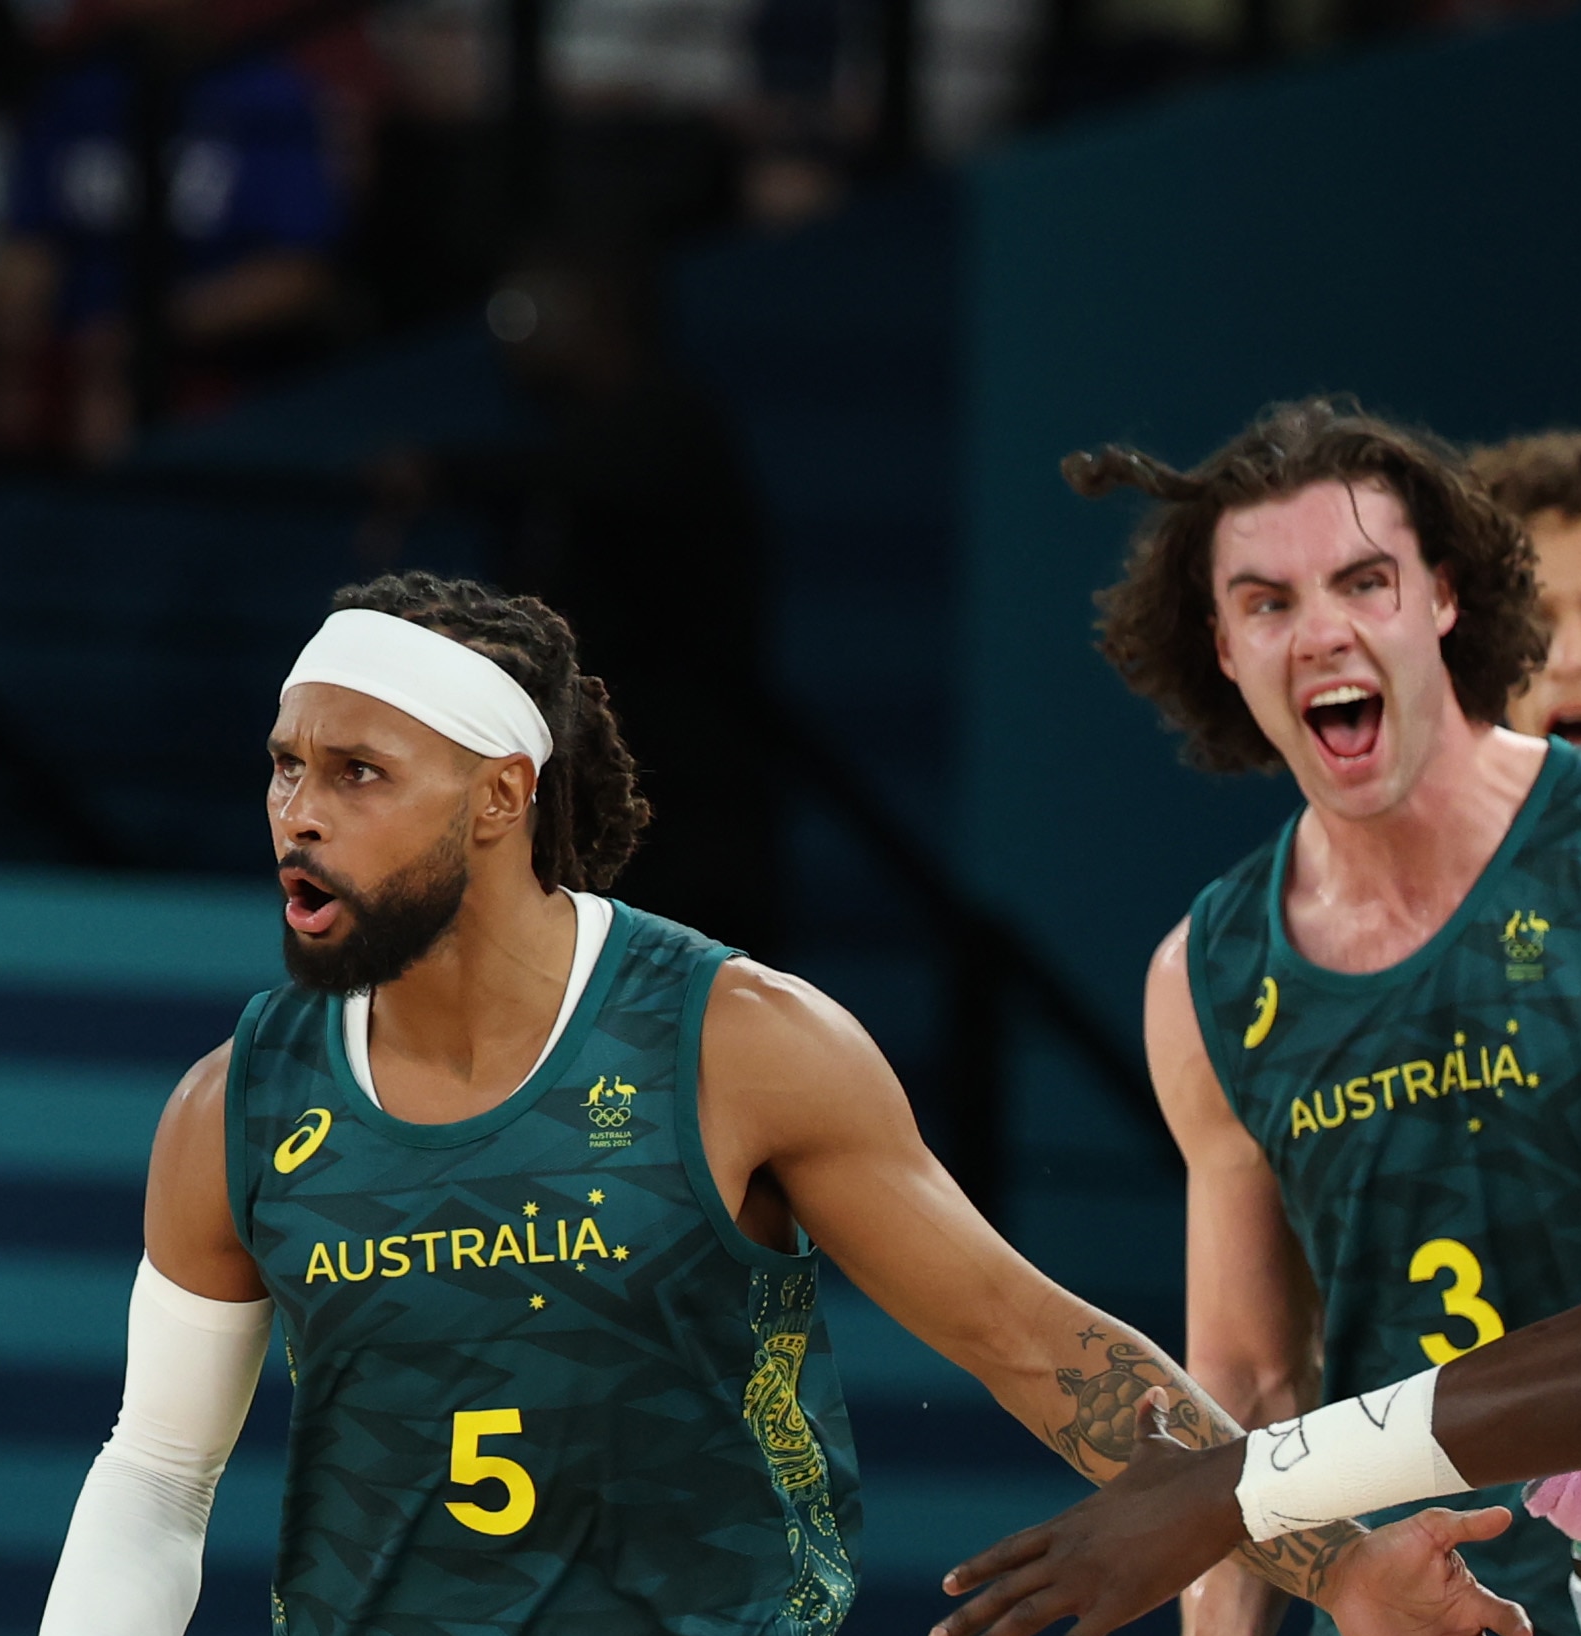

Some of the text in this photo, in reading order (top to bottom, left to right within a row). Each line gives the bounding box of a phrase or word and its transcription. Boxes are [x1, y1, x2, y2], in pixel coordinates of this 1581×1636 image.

[1290, 1044, 1525, 1139] AUSTRALIA
[589, 1131, 632, 1139] AUSTRALIA
[613, 1139, 631, 1147] 2024
[305, 1217, 609, 1284] AUSTRALIA
[1408, 1238, 1505, 1367] 3
[444, 1408, 536, 1536] 5
